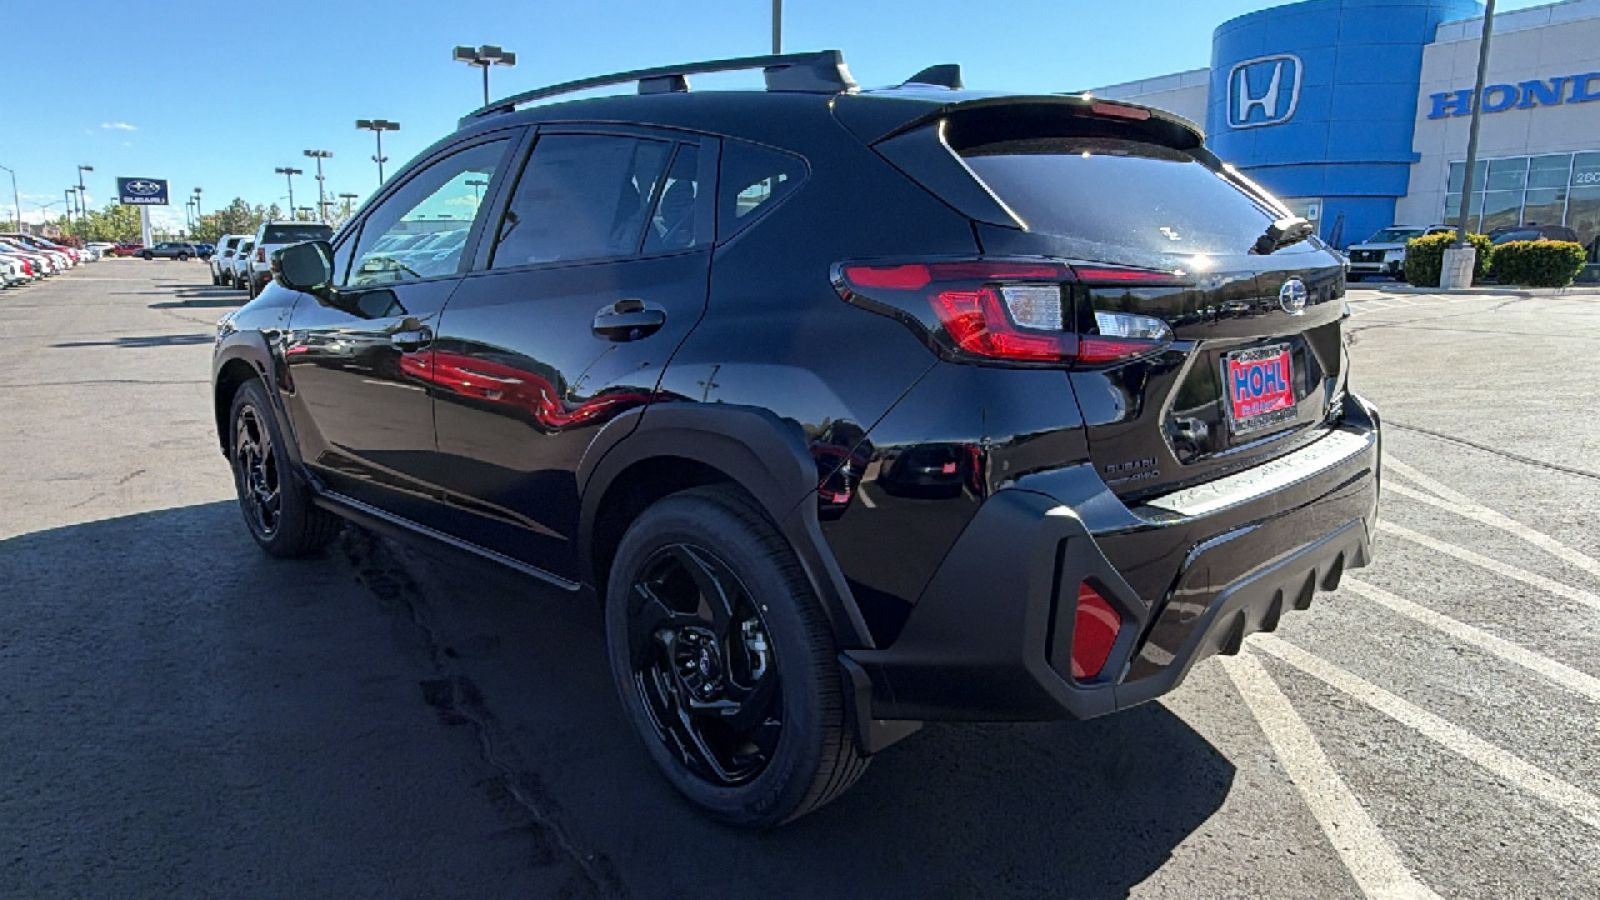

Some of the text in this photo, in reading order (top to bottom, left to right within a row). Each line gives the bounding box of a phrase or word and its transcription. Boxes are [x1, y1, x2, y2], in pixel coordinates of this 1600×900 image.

[123, 196, 166, 204] SUBARU
[1234, 361, 1286, 402] HOHL
[1105, 457, 1158, 472] SUBARU
